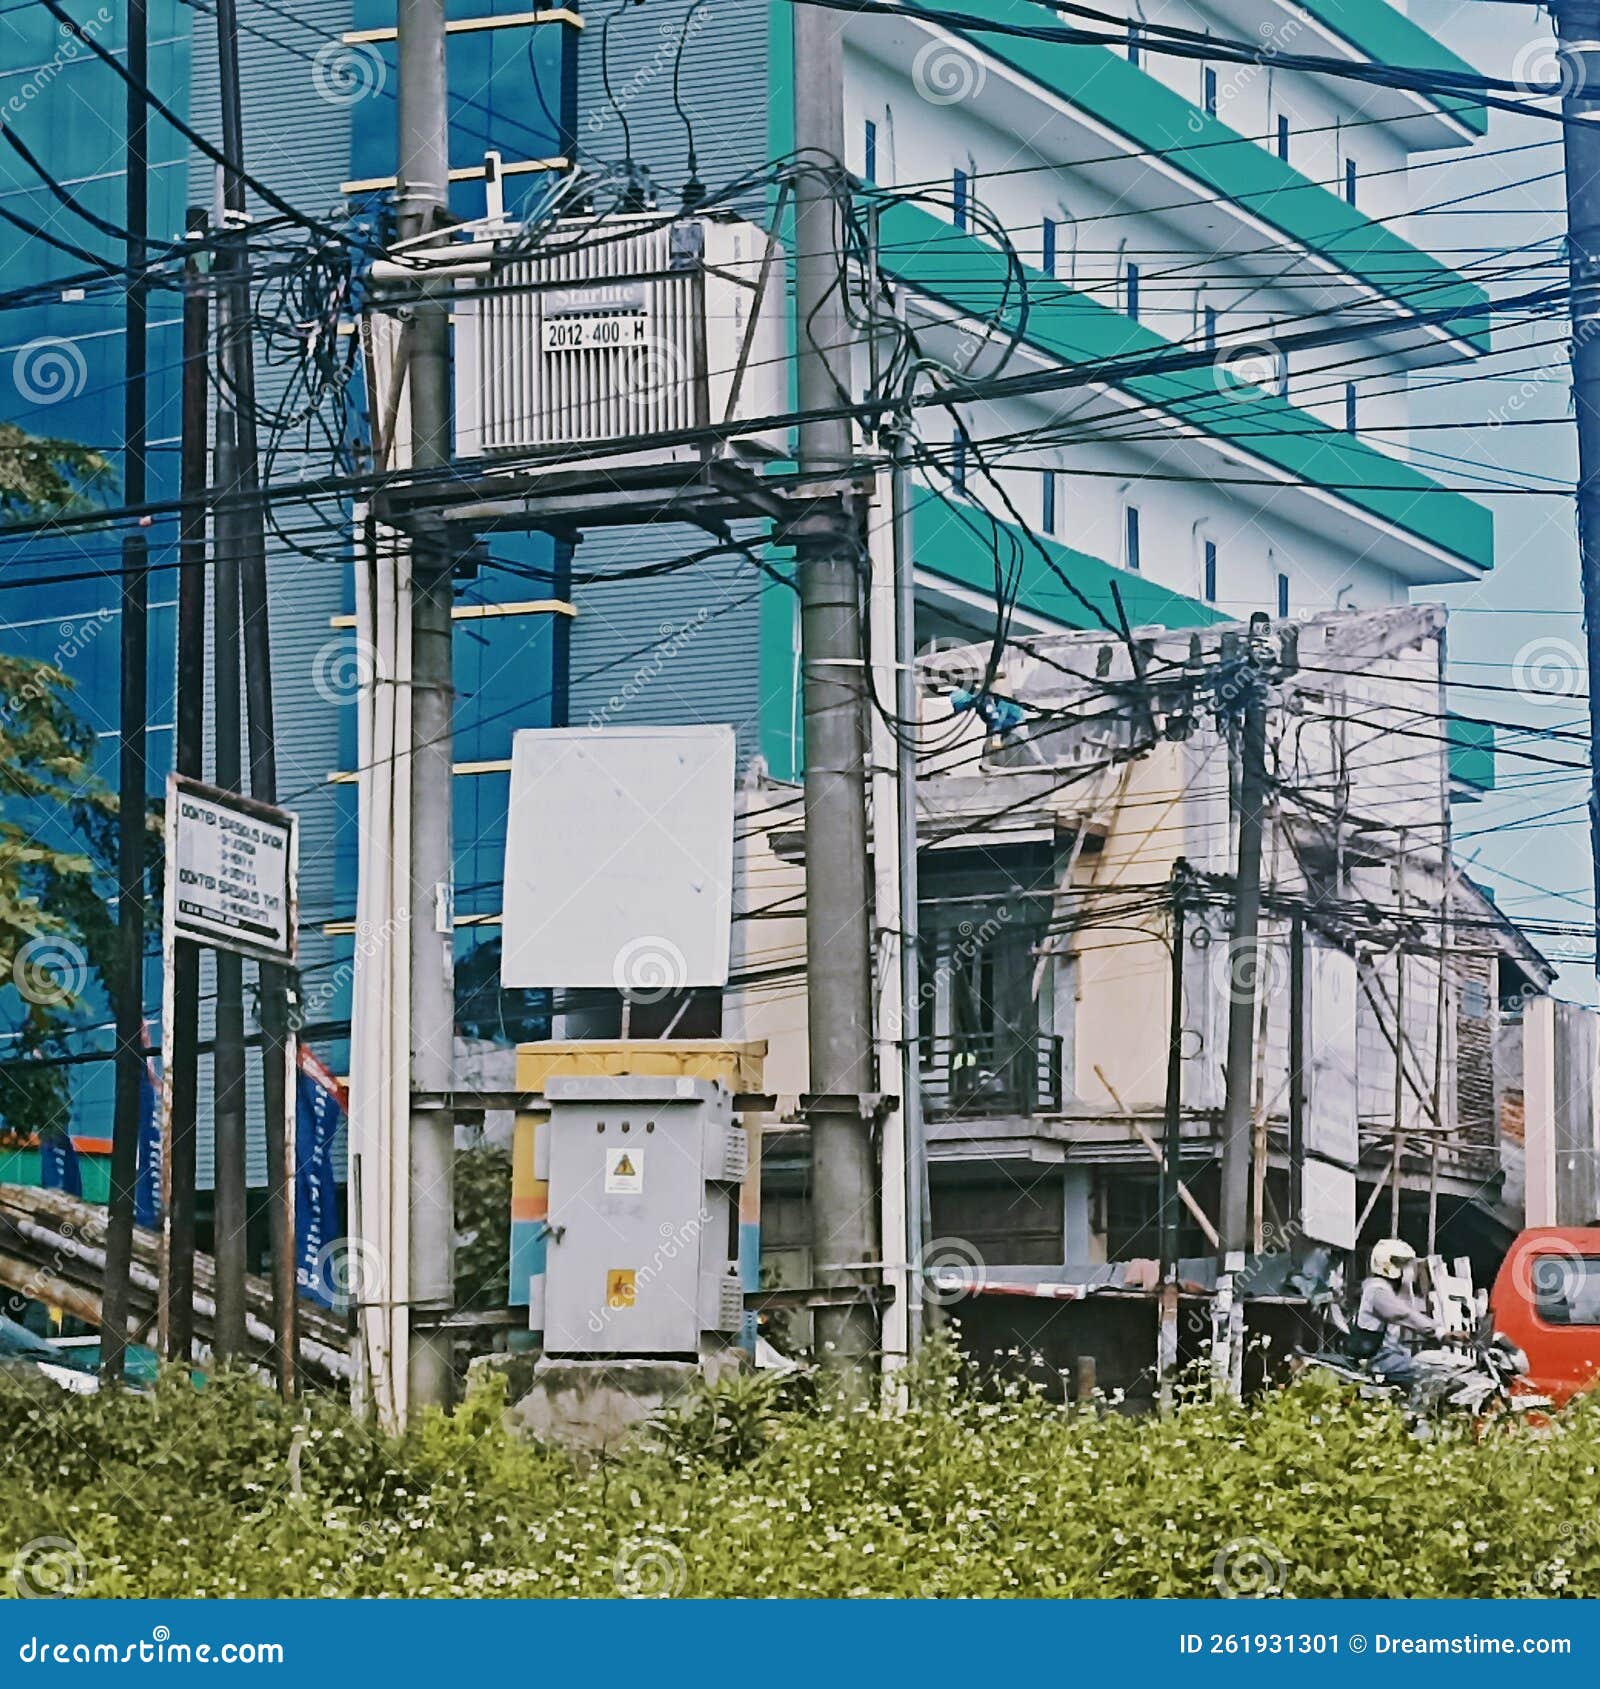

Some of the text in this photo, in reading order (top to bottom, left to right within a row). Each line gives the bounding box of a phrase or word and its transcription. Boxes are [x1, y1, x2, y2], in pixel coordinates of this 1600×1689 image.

[549, 323, 582, 346] 2012
[592, 321, 620, 343] 400
[634, 320, 645, 340] H
